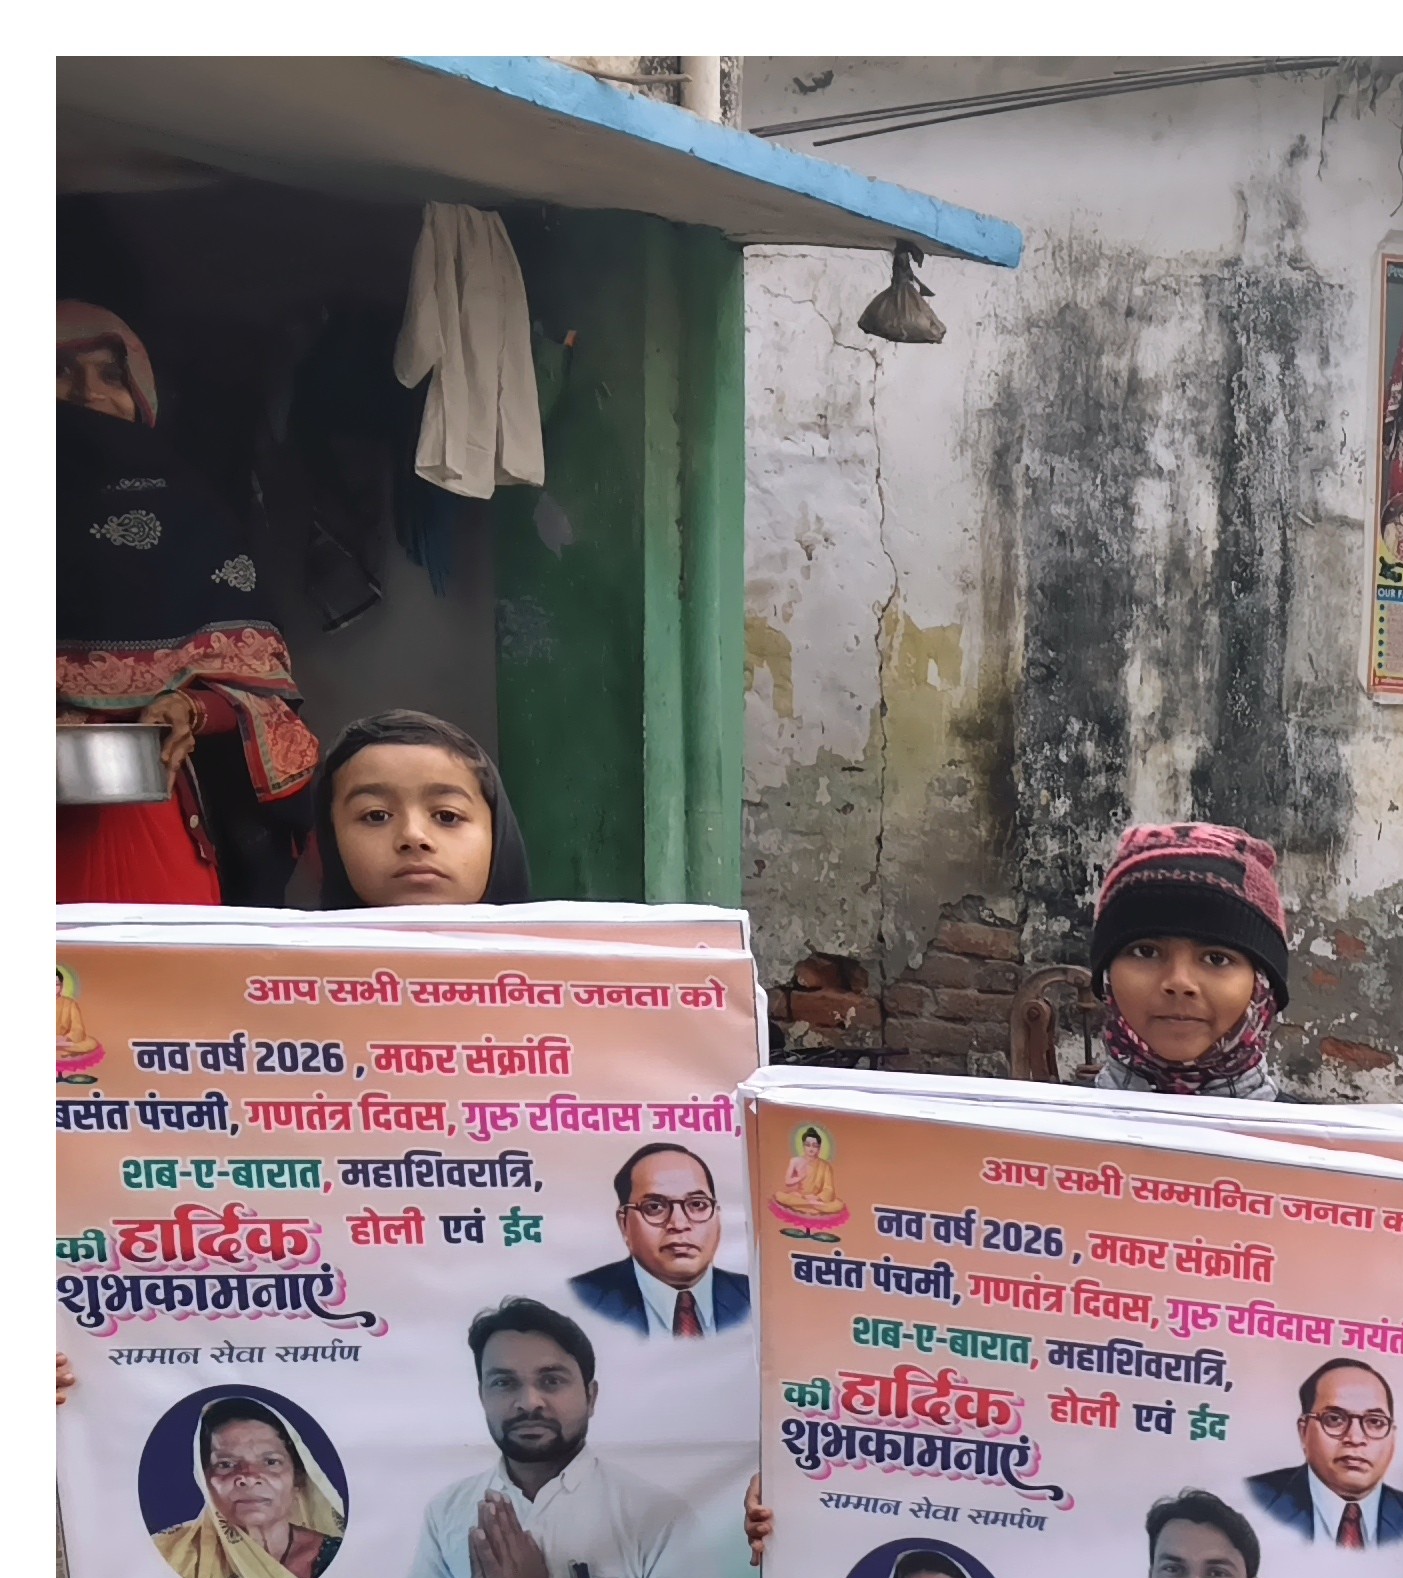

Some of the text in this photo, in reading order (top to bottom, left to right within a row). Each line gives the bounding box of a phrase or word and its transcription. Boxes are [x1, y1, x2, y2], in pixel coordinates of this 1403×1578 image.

[1378, 588, 1396, 600] OUR
[131, 1041, 191, 1072] नव
[195, 1032, 247, 1072] वर्ष
[369, 1044, 457, 1074] मकर
[461, 1036, 571, 1076] संक्रांति
[122, 1149, 543, 1194] शब-ए-बारात, महाशिवरात्रि,
[982, 1160, 1048, 1187] आप
[1056, 1164, 1124, 1196] सभी
[1131, 1177, 1274, 1216] सम्मानित
[1281, 1197, 1375, 1229] जनता
[346, 1205, 544, 1247] होली एवं ईद
[874, 1207, 927, 1241] नव
[930, 1208, 977, 1247] वर्ष
[1088, 1233, 1169, 1270] मकर
[1173, 1238, 1275, 1283] संक्रांति
[108, 1338, 362, 1366] सम्मान सेवा समर्पण
[781, 1364, 1016, 1435] की हार्दिक
[781, 1413, 1064, 1502] शुभकामनाएं
